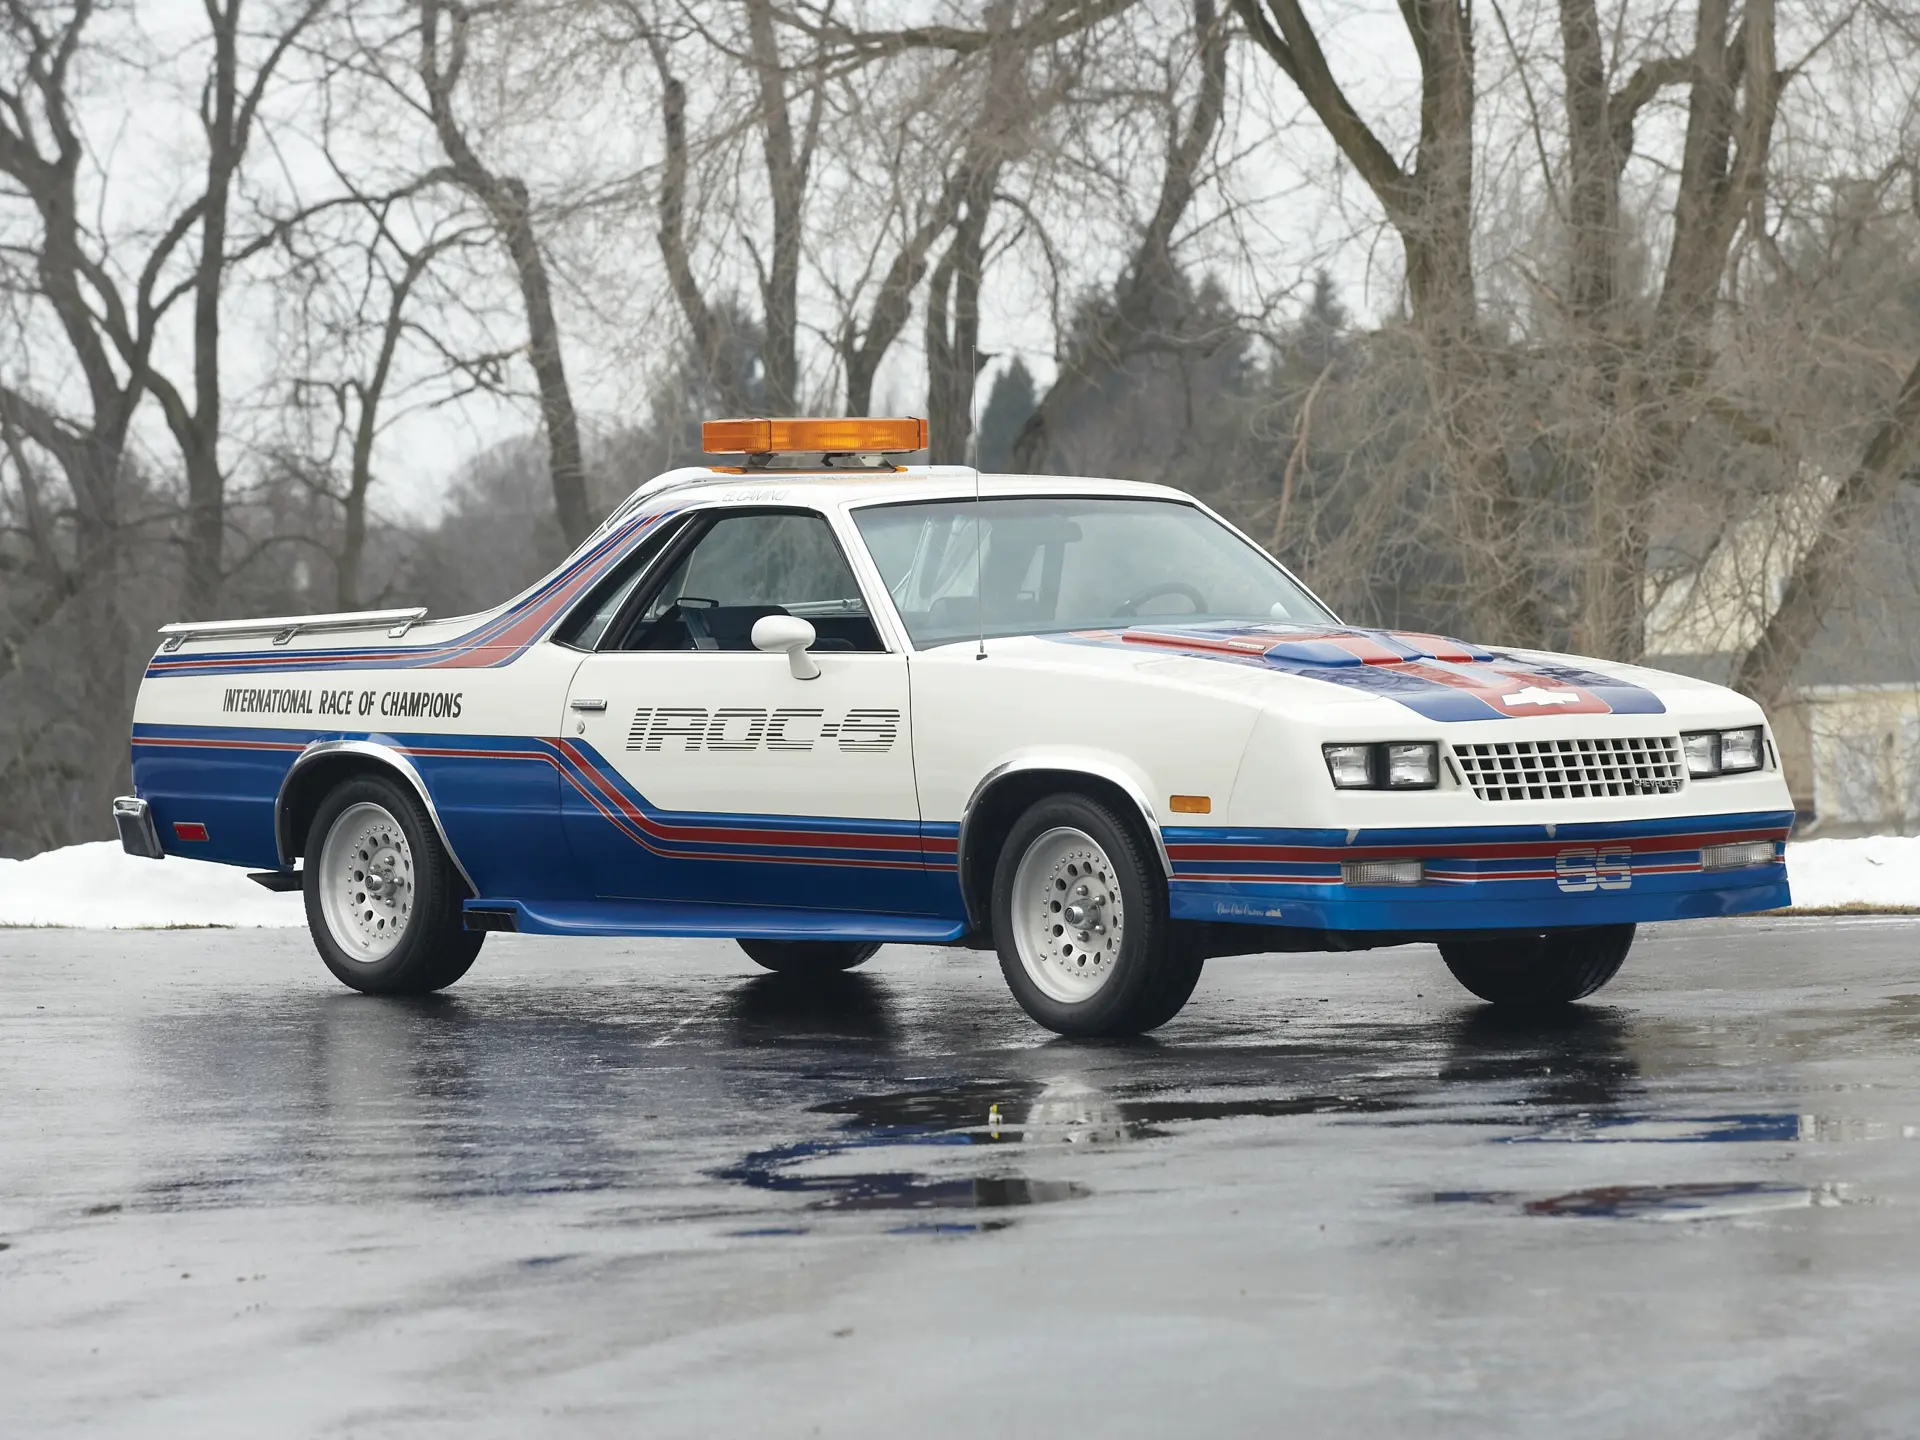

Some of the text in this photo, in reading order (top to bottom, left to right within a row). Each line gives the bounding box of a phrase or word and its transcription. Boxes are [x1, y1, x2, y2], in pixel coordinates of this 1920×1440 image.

[222, 688, 463, 718] INTERNATIONAL RACE OF CHAMPIONS
[1633, 779, 1681, 789] CHEVROLET
[1555, 846, 1632, 892] SS
